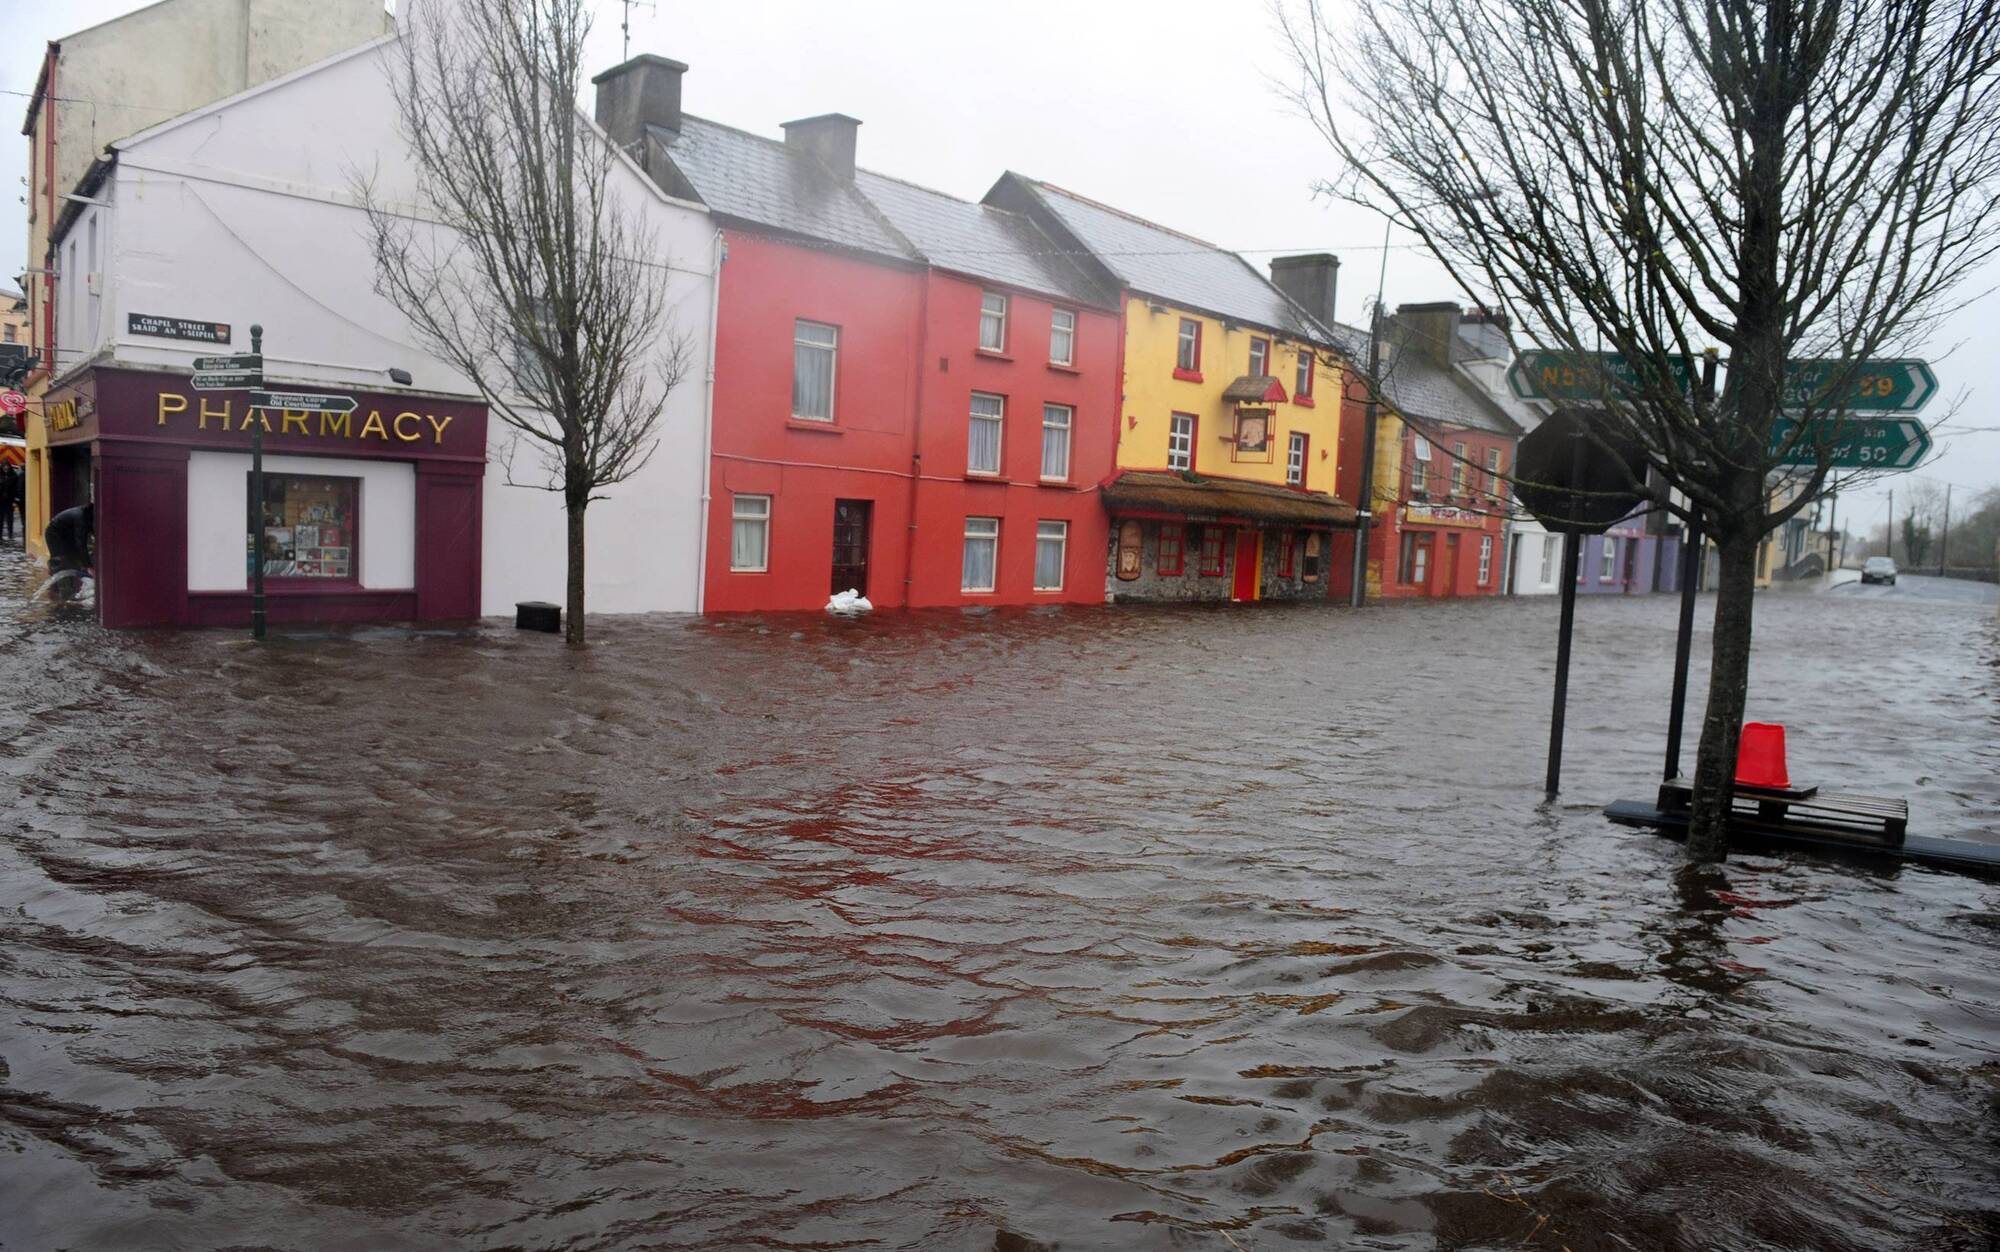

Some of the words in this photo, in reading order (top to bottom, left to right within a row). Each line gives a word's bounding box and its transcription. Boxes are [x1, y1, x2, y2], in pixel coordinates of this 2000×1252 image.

[141, 317, 171, 328] CHAPEL
[178, 321, 206, 331] STREET
[164, 327, 177, 335] AN
[157, 392, 454, 444] PHARMACY
[1859, 446, 1887, 462] 50
